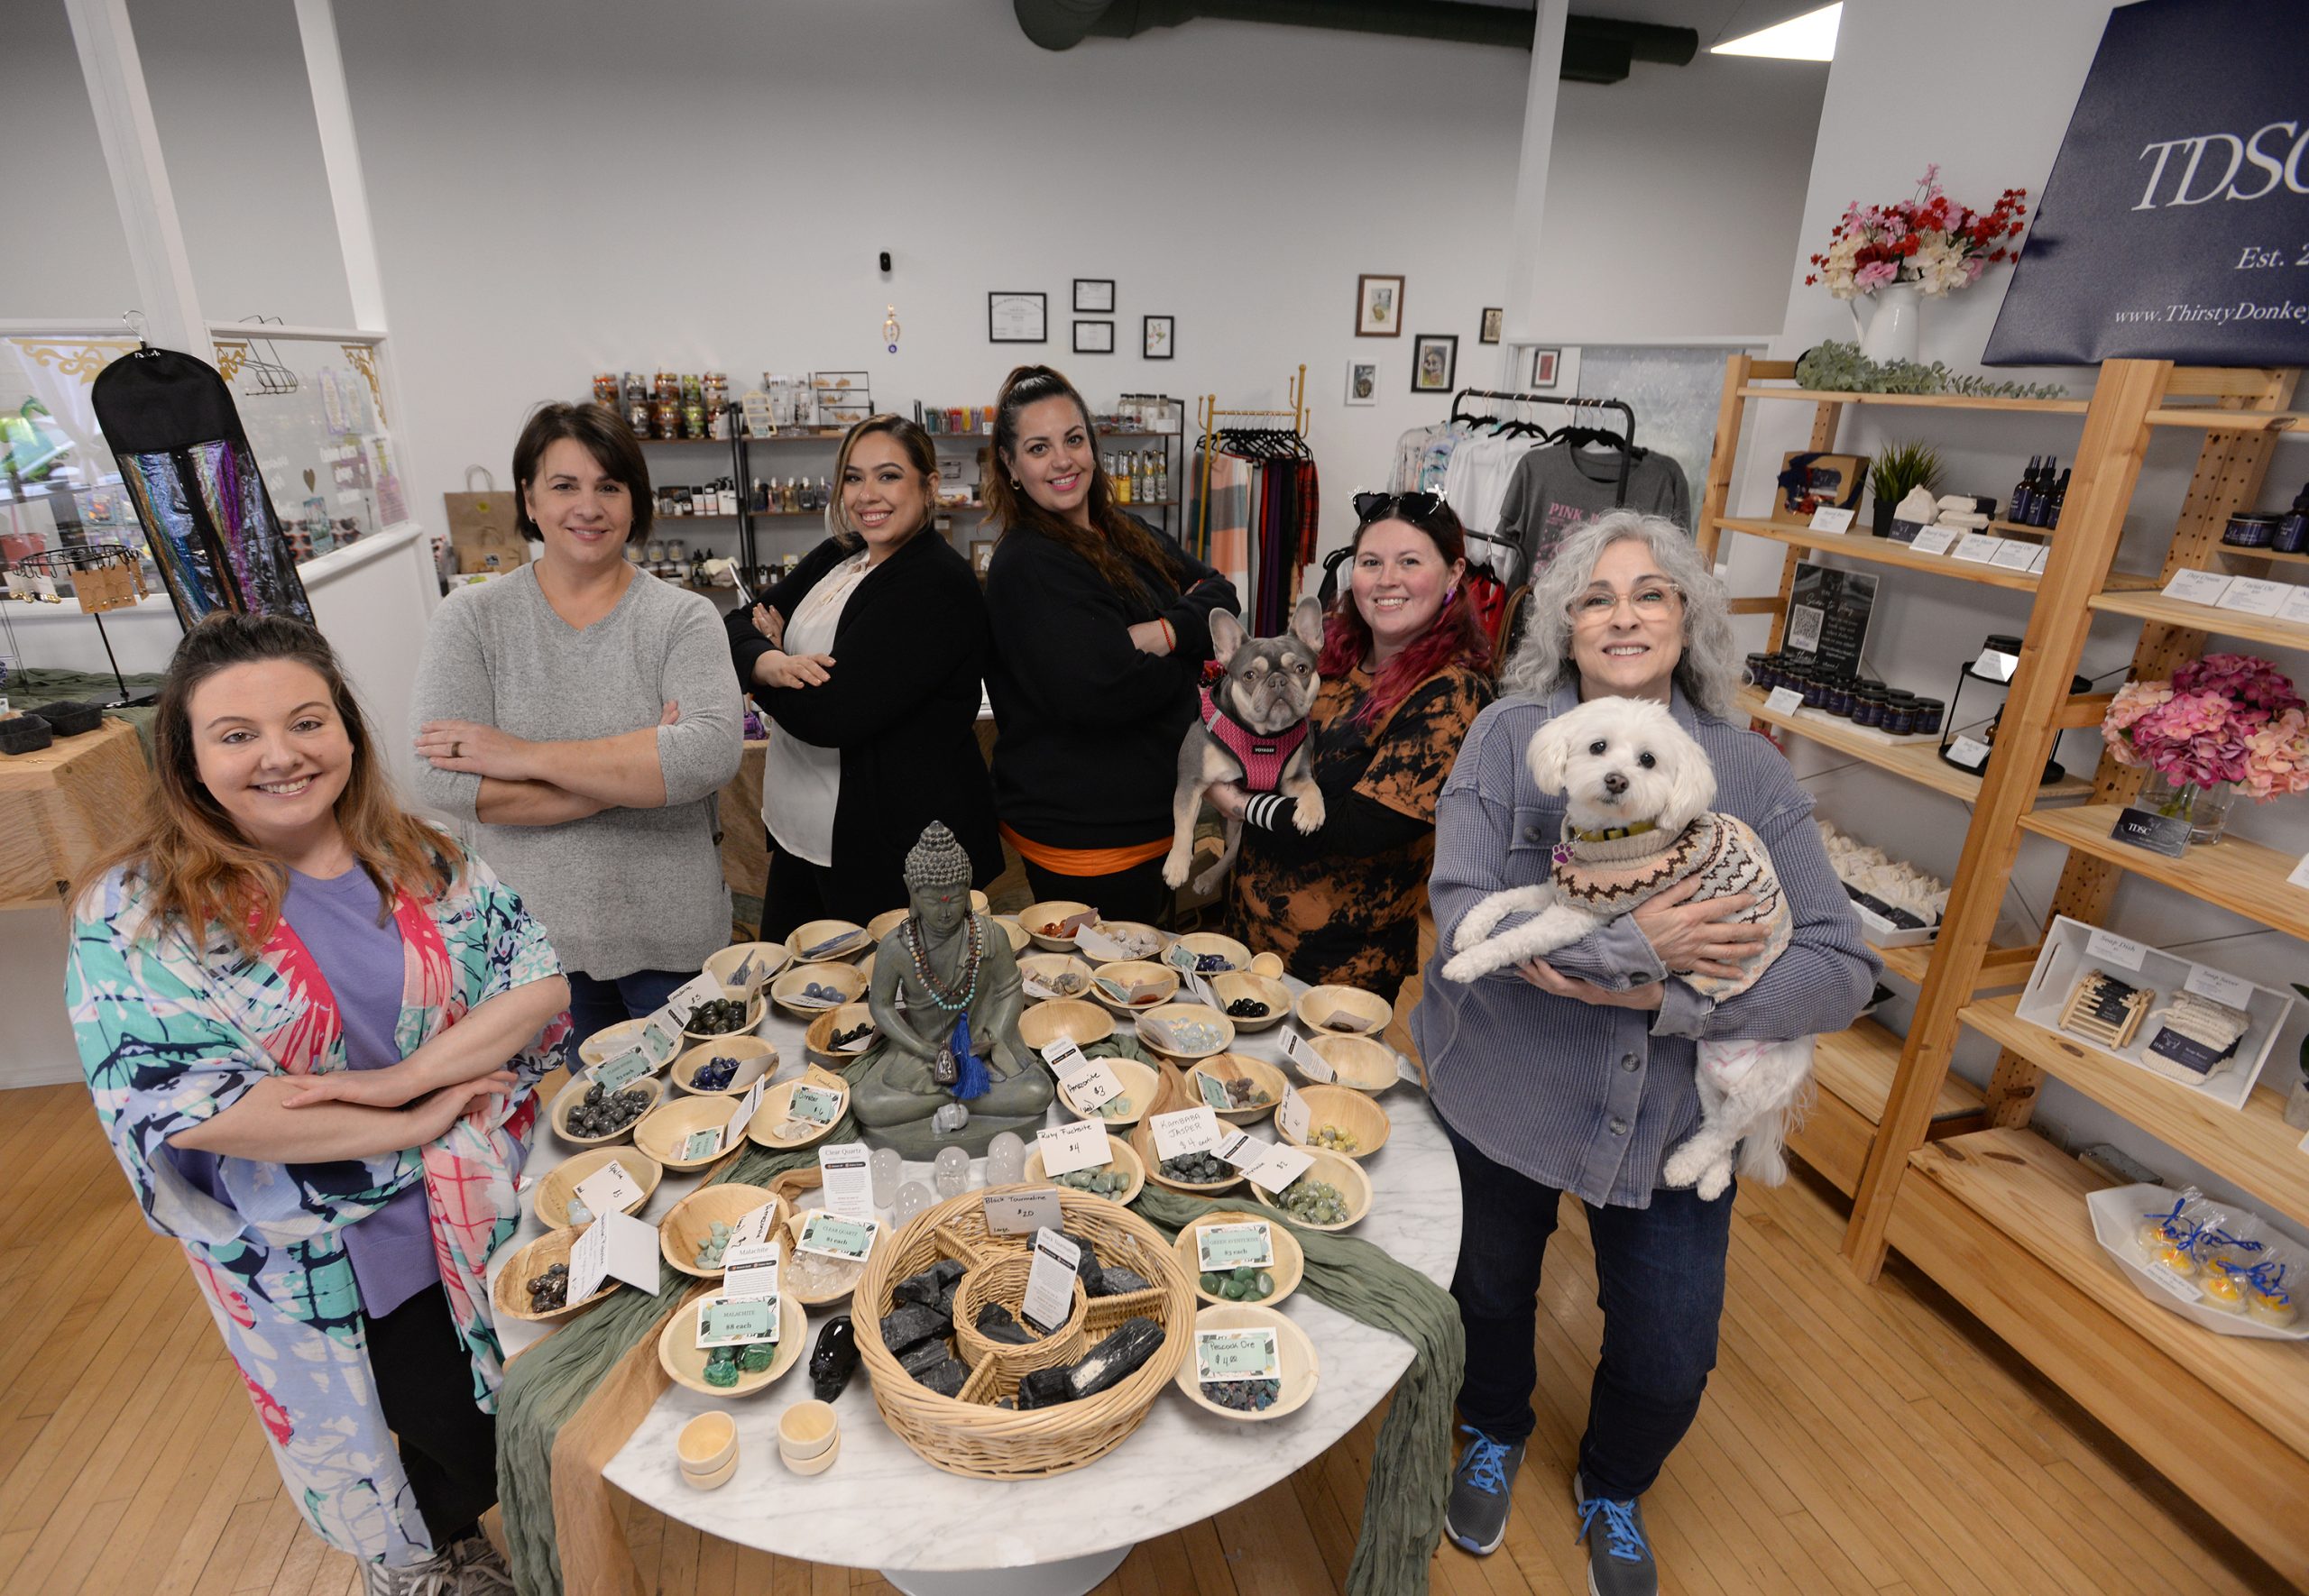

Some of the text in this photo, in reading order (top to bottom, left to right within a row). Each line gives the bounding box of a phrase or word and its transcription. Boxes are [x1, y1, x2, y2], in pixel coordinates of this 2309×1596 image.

[2234, 246, 2285, 270] Est.
[1549, 502, 1584, 520] PINK
[2129, 821, 2152, 836] TDSC
[2100, 934, 2136, 954] Soap Dish
[1067, 1071, 1100, 1094] Amazonite
[1093, 1085, 1106, 1096] $3
[1037, 1130, 1058, 1141] Ruby
[1168, 1123, 1202, 1138] JASPER
[841, 1148, 861, 1156] Quartz
[1069, 1142, 1081, 1153] $4
[984, 1195, 1047, 1205] Black Tourmaline
[1017, 1208, 1035, 1217] $20
[823, 1225, 859, 1237] CLEAR QUARTZ
[739, 1246, 769, 1256] Malachite
[1233, 1248, 1248, 1256] each
[723, 1309, 755, 1318] MALACHITE
[735, 1322, 752, 1330] each
[1210, 1340, 1256, 1351] Peacock Ore
